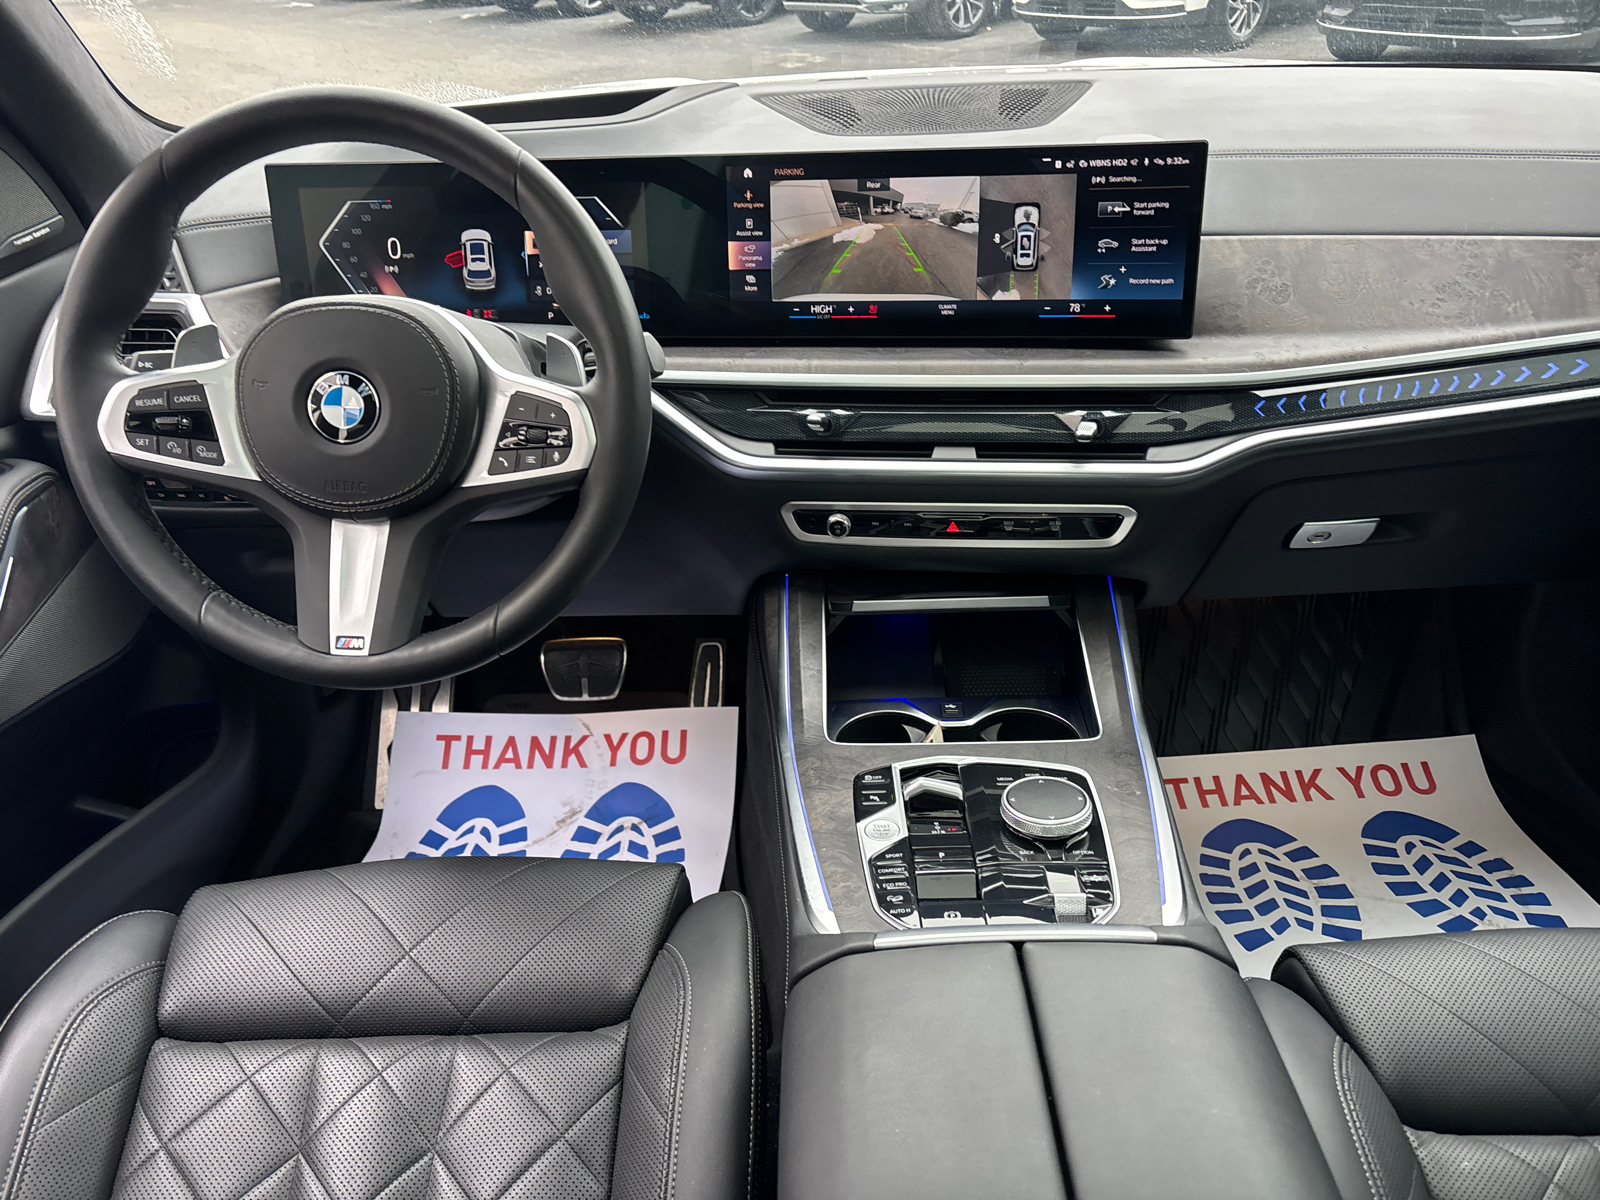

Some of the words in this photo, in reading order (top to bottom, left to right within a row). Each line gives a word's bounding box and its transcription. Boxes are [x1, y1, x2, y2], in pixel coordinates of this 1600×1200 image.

[1089, 159, 1111, 167] WBNS
[1112, 158, 1128, 167] HD2
[774, 168, 805, 176] PARKING
[866, 181, 881, 189] Rear
[1133, 201, 1147, 209] Start
[1148, 201, 1170, 209] parking
[360, 214, 371, 222] 120
[1145, 238, 1169, 246] back-up
[387, 237, 402, 260] 0
[810, 304, 833, 314] HIGH
[1069, 303, 1081, 313] 78
[547, 311, 554, 320] P
[314, 374, 373, 398] BMW
[134, 397, 165, 407] RESUME
[173, 394, 202, 404] CANCEL
[135, 438, 150, 447] SET
[199, 451, 218, 459] MODE
[323, 479, 368, 494] AIRBAG
[435, 733, 590, 771] THANK
[603, 729, 689, 767] YOU
[1162, 768, 1336, 811] THANK
[1336, 760, 1438, 799] YOU
[877, 866, 906, 874] COMFORT
